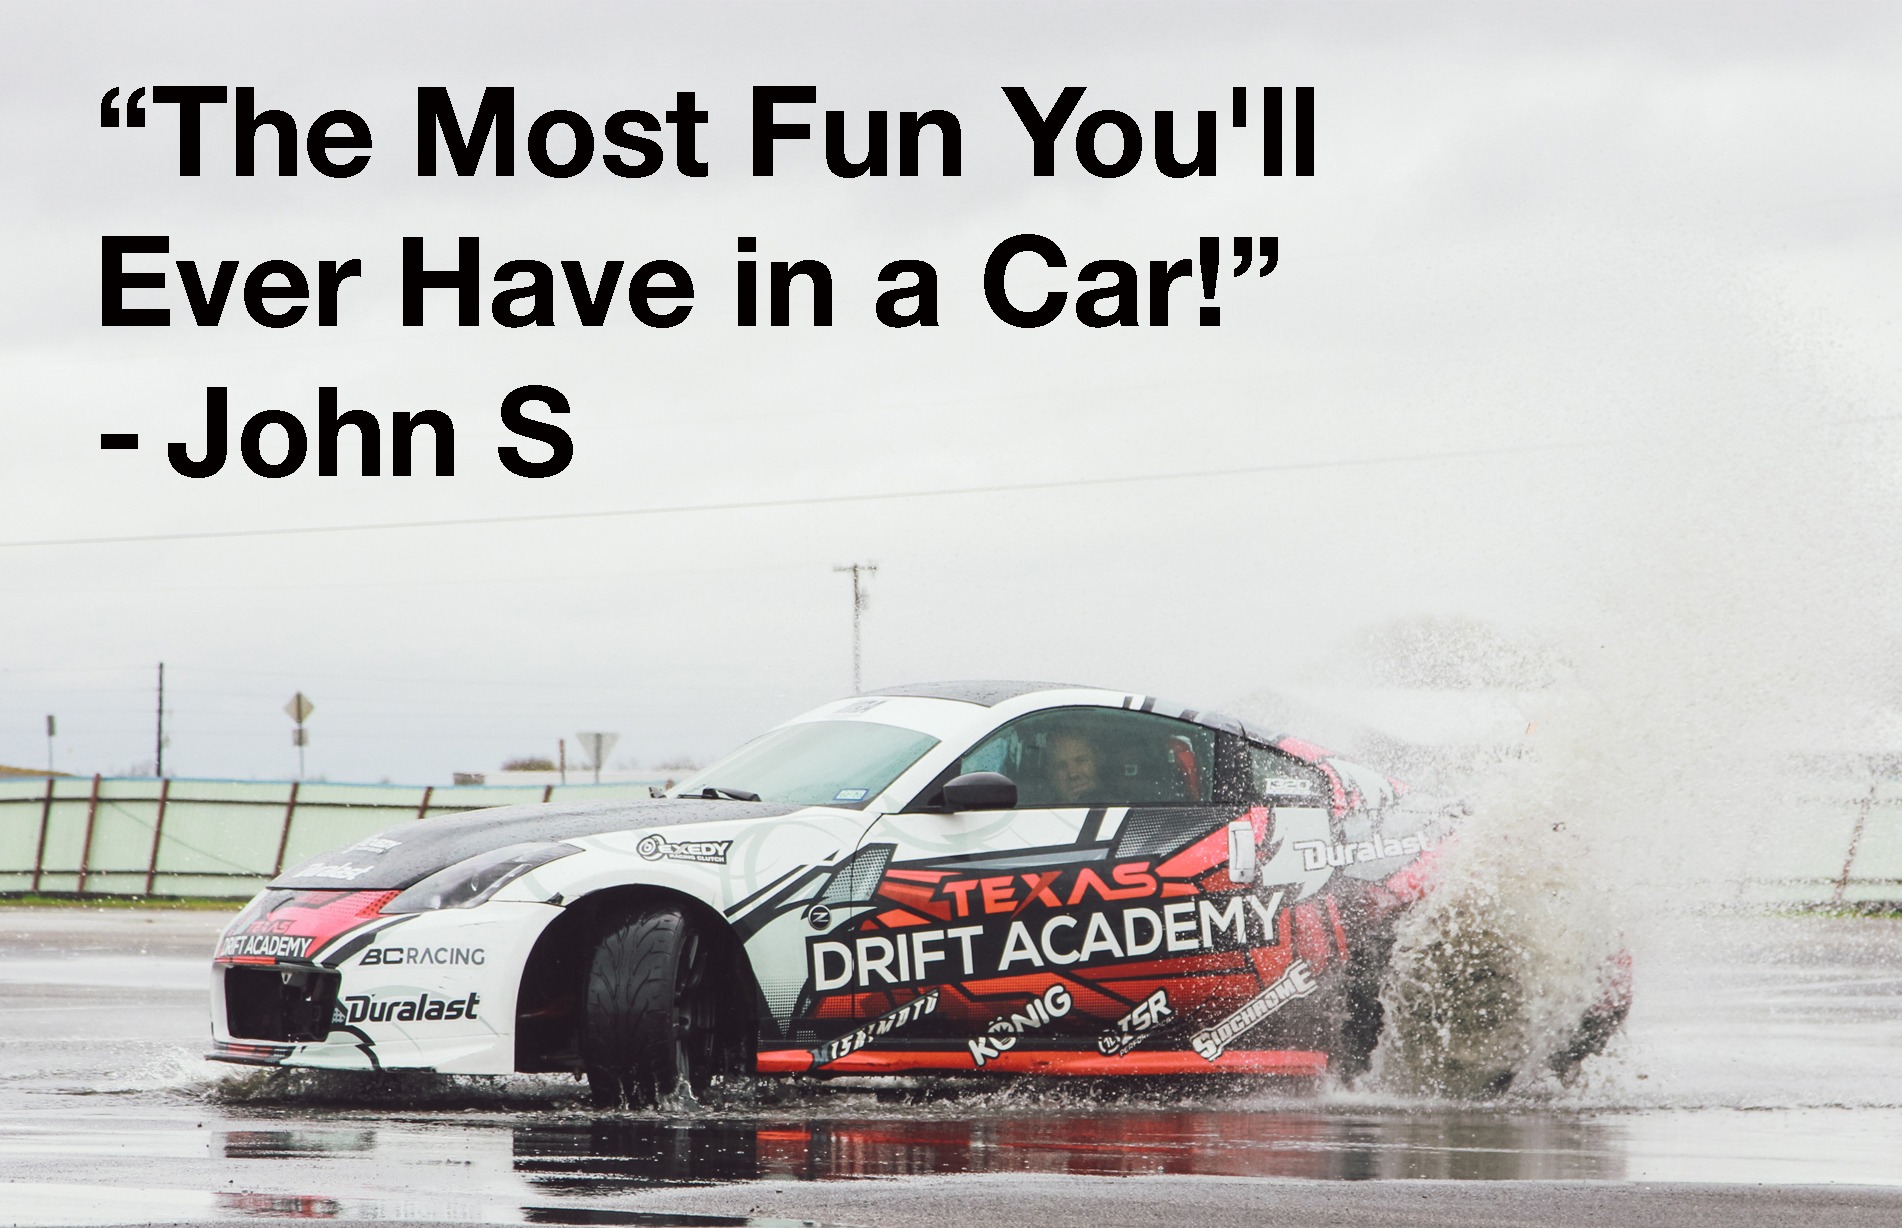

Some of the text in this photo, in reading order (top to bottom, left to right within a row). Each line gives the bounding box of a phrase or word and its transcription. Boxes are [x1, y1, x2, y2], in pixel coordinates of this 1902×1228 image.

[658, 842, 729, 856] EXEDY
[1293, 831, 1429, 871] Duralast
[943, 861, 1156, 918] TEXAS
[243, 936, 313, 957] ACADEMY
[406, 948, 485, 965] RACING
[813, 892, 1282, 991] DRIFT ACADEMY
[345, 993, 480, 1023] Duralast
[1117, 990, 1173, 1046] TSR
[1190, 960, 1318, 1060] SIDCHROME
